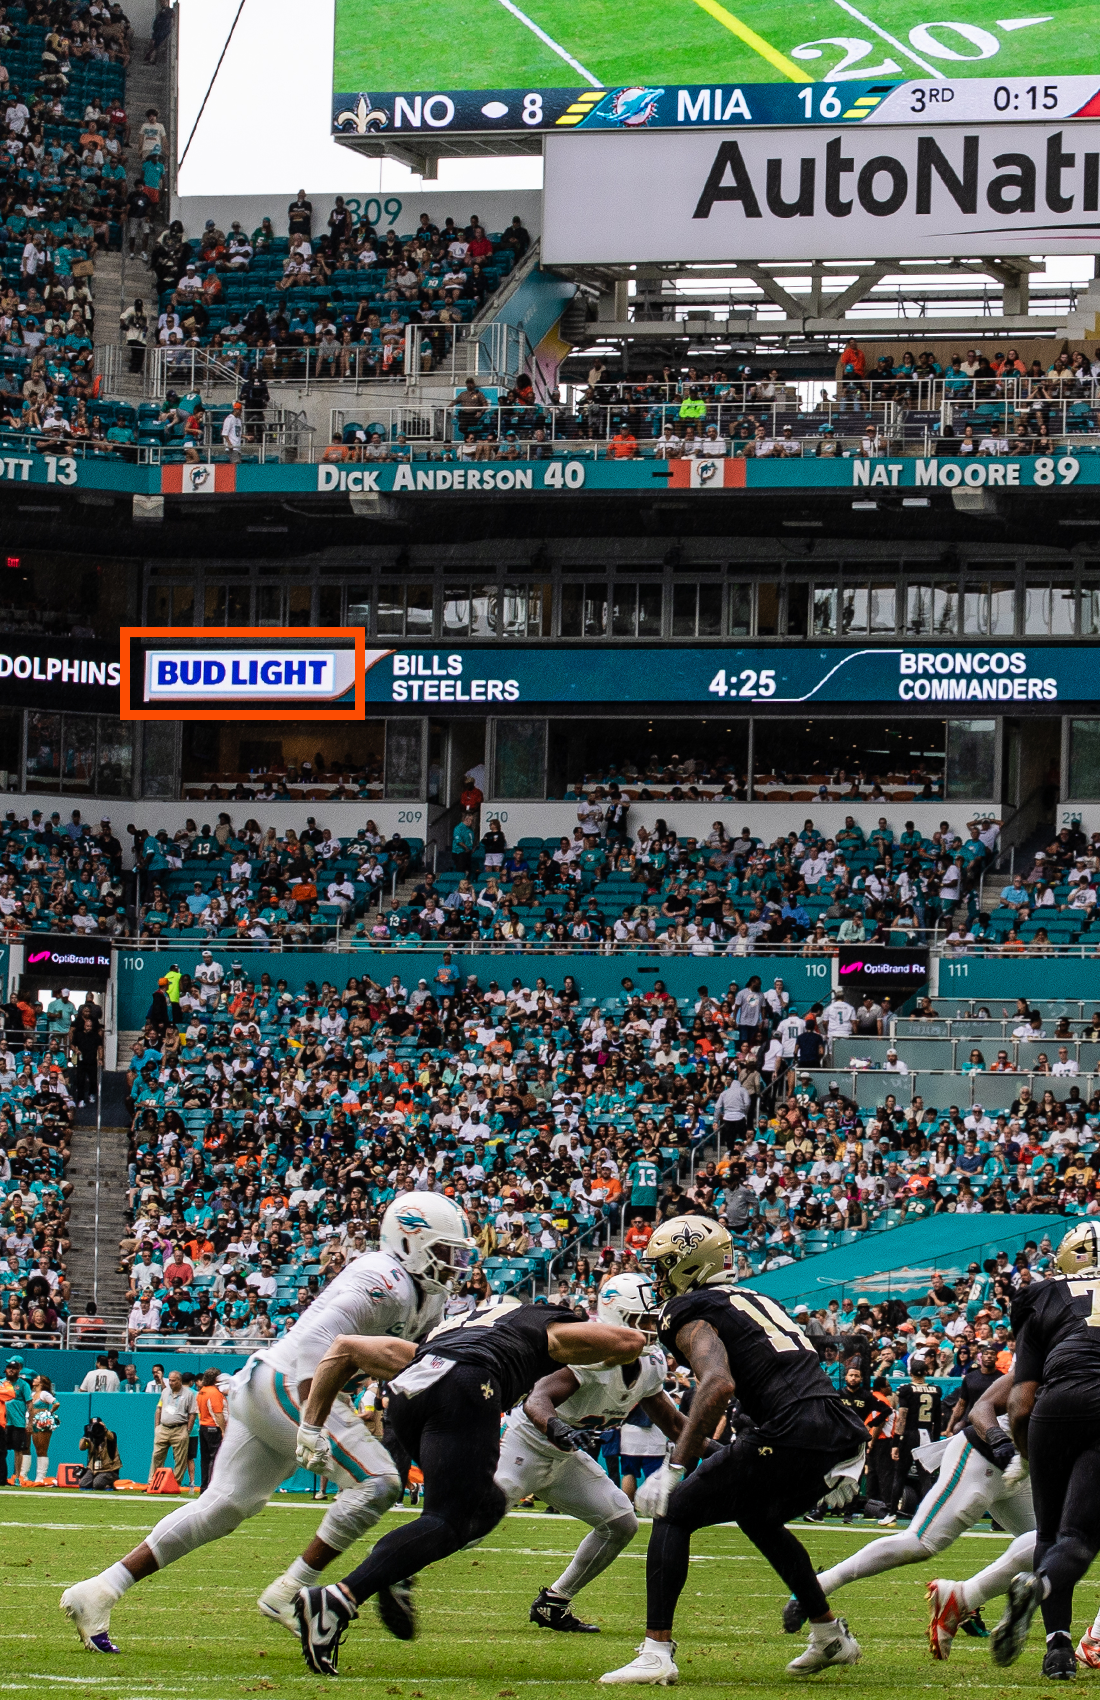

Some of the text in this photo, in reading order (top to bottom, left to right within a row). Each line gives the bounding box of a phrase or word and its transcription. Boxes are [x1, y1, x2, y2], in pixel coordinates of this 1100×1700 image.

[522, 93, 543, 125] 8
[677, 88, 752, 122] MIA
[797, 86, 842, 119] 16
[910, 87, 955, 113] 3RD
[993, 85, 1058, 112] 0:15
[394, 95, 455, 128] NO
[345, 197, 403, 228] 309
[0, 456, 78, 486] TT 13
[317, 461, 586, 492] DICK ANDERSON 40
[852, 456, 1080, 487] NAT MOORE 89
[0, 654, 121, 687] DOLPHINS
[157, 660, 328, 686] BUD LIGHT
[393, 655, 462, 675] BILLS
[900, 652, 1026, 674] BRONCOS
[392, 680, 520, 701] STEELERS
[708, 669, 777, 697] 4:25
[899, 678, 1058, 700] COMMANDERS
[398, 811, 422, 823] 209
[485, 811, 509, 823] 210
[51, 952, 110, 966] OptiBrand Rx
[124, 957, 144, 971] 110
[864, 963, 926, 975] OptiBrand Rx
[805, 963, 827, 978] 110
[948, 964, 969, 977] 111
[838, 1011, 843, 1024] 1
[788, 1026, 798, 1039] 10
[638, 1168, 657, 1187] 13
[908, 1201, 925, 1214] 26
[918, 1393, 933, 1422] 2
[150, 1470, 167, 1491] 10
